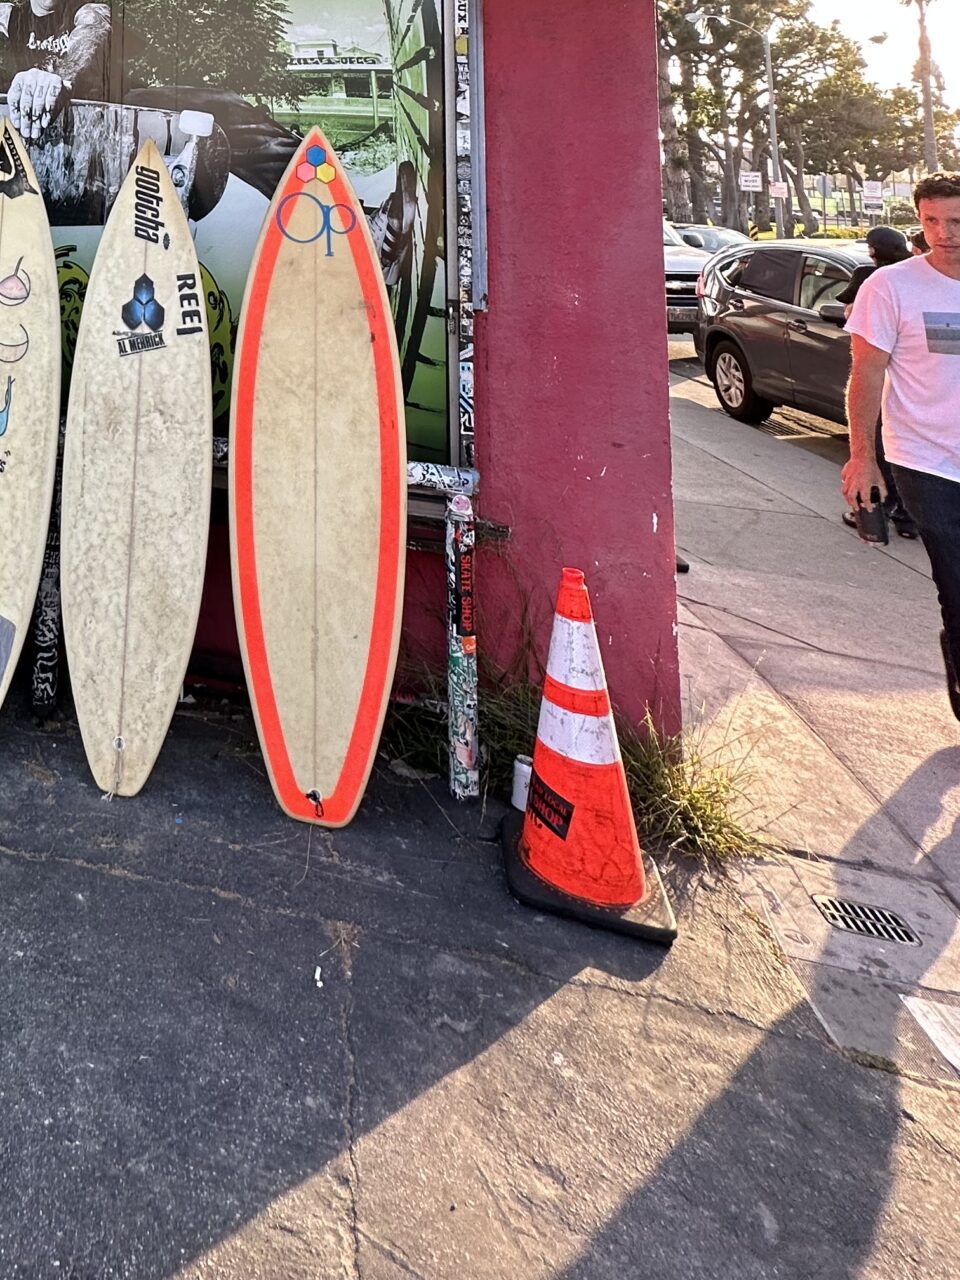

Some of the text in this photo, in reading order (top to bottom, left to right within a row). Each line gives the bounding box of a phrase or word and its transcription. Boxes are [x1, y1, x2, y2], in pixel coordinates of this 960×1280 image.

[134, 164, 160, 244] gotcha
[118, 332, 165, 355] AL MERRICK
[461, 554, 471, 592] SKATE
[461, 597, 473, 632] SHOP
[545, 793, 567, 816] LOCAL
